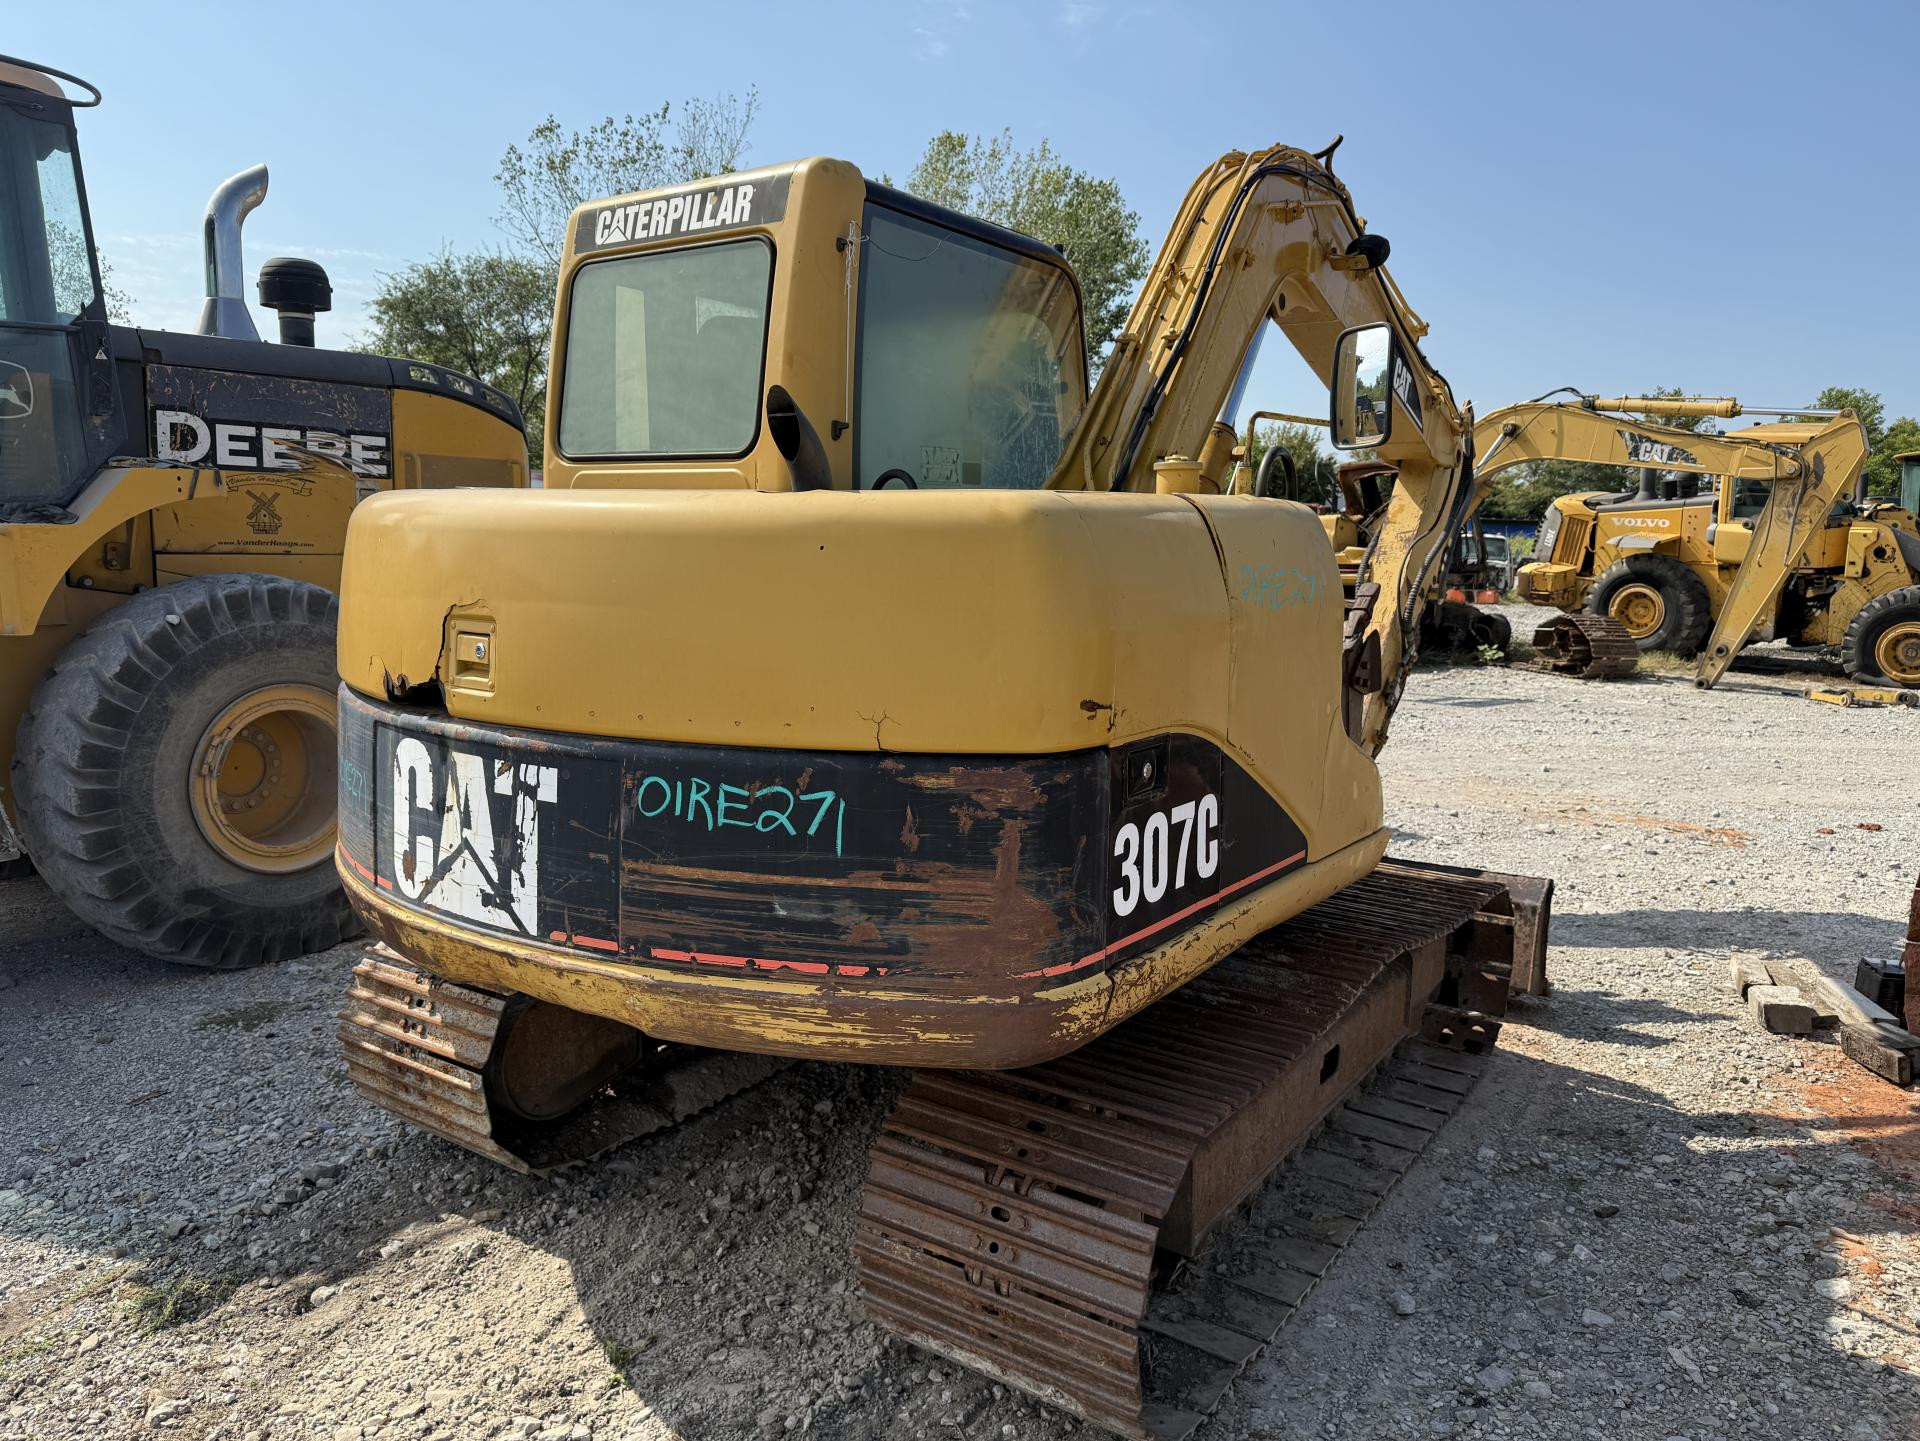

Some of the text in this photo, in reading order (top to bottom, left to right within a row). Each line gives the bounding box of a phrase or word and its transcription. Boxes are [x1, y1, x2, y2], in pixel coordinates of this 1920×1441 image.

[595, 184, 754, 246] CATERPILLAR
[1393, 357, 1412, 404] CAT
[156, 409, 388, 475] DEERE
[1638, 441, 1672, 464] CAT
[1610, 517, 1670, 528] VOLVO
[394, 737, 558, 937] CAT
[1113, 793, 1219, 917] 307C
